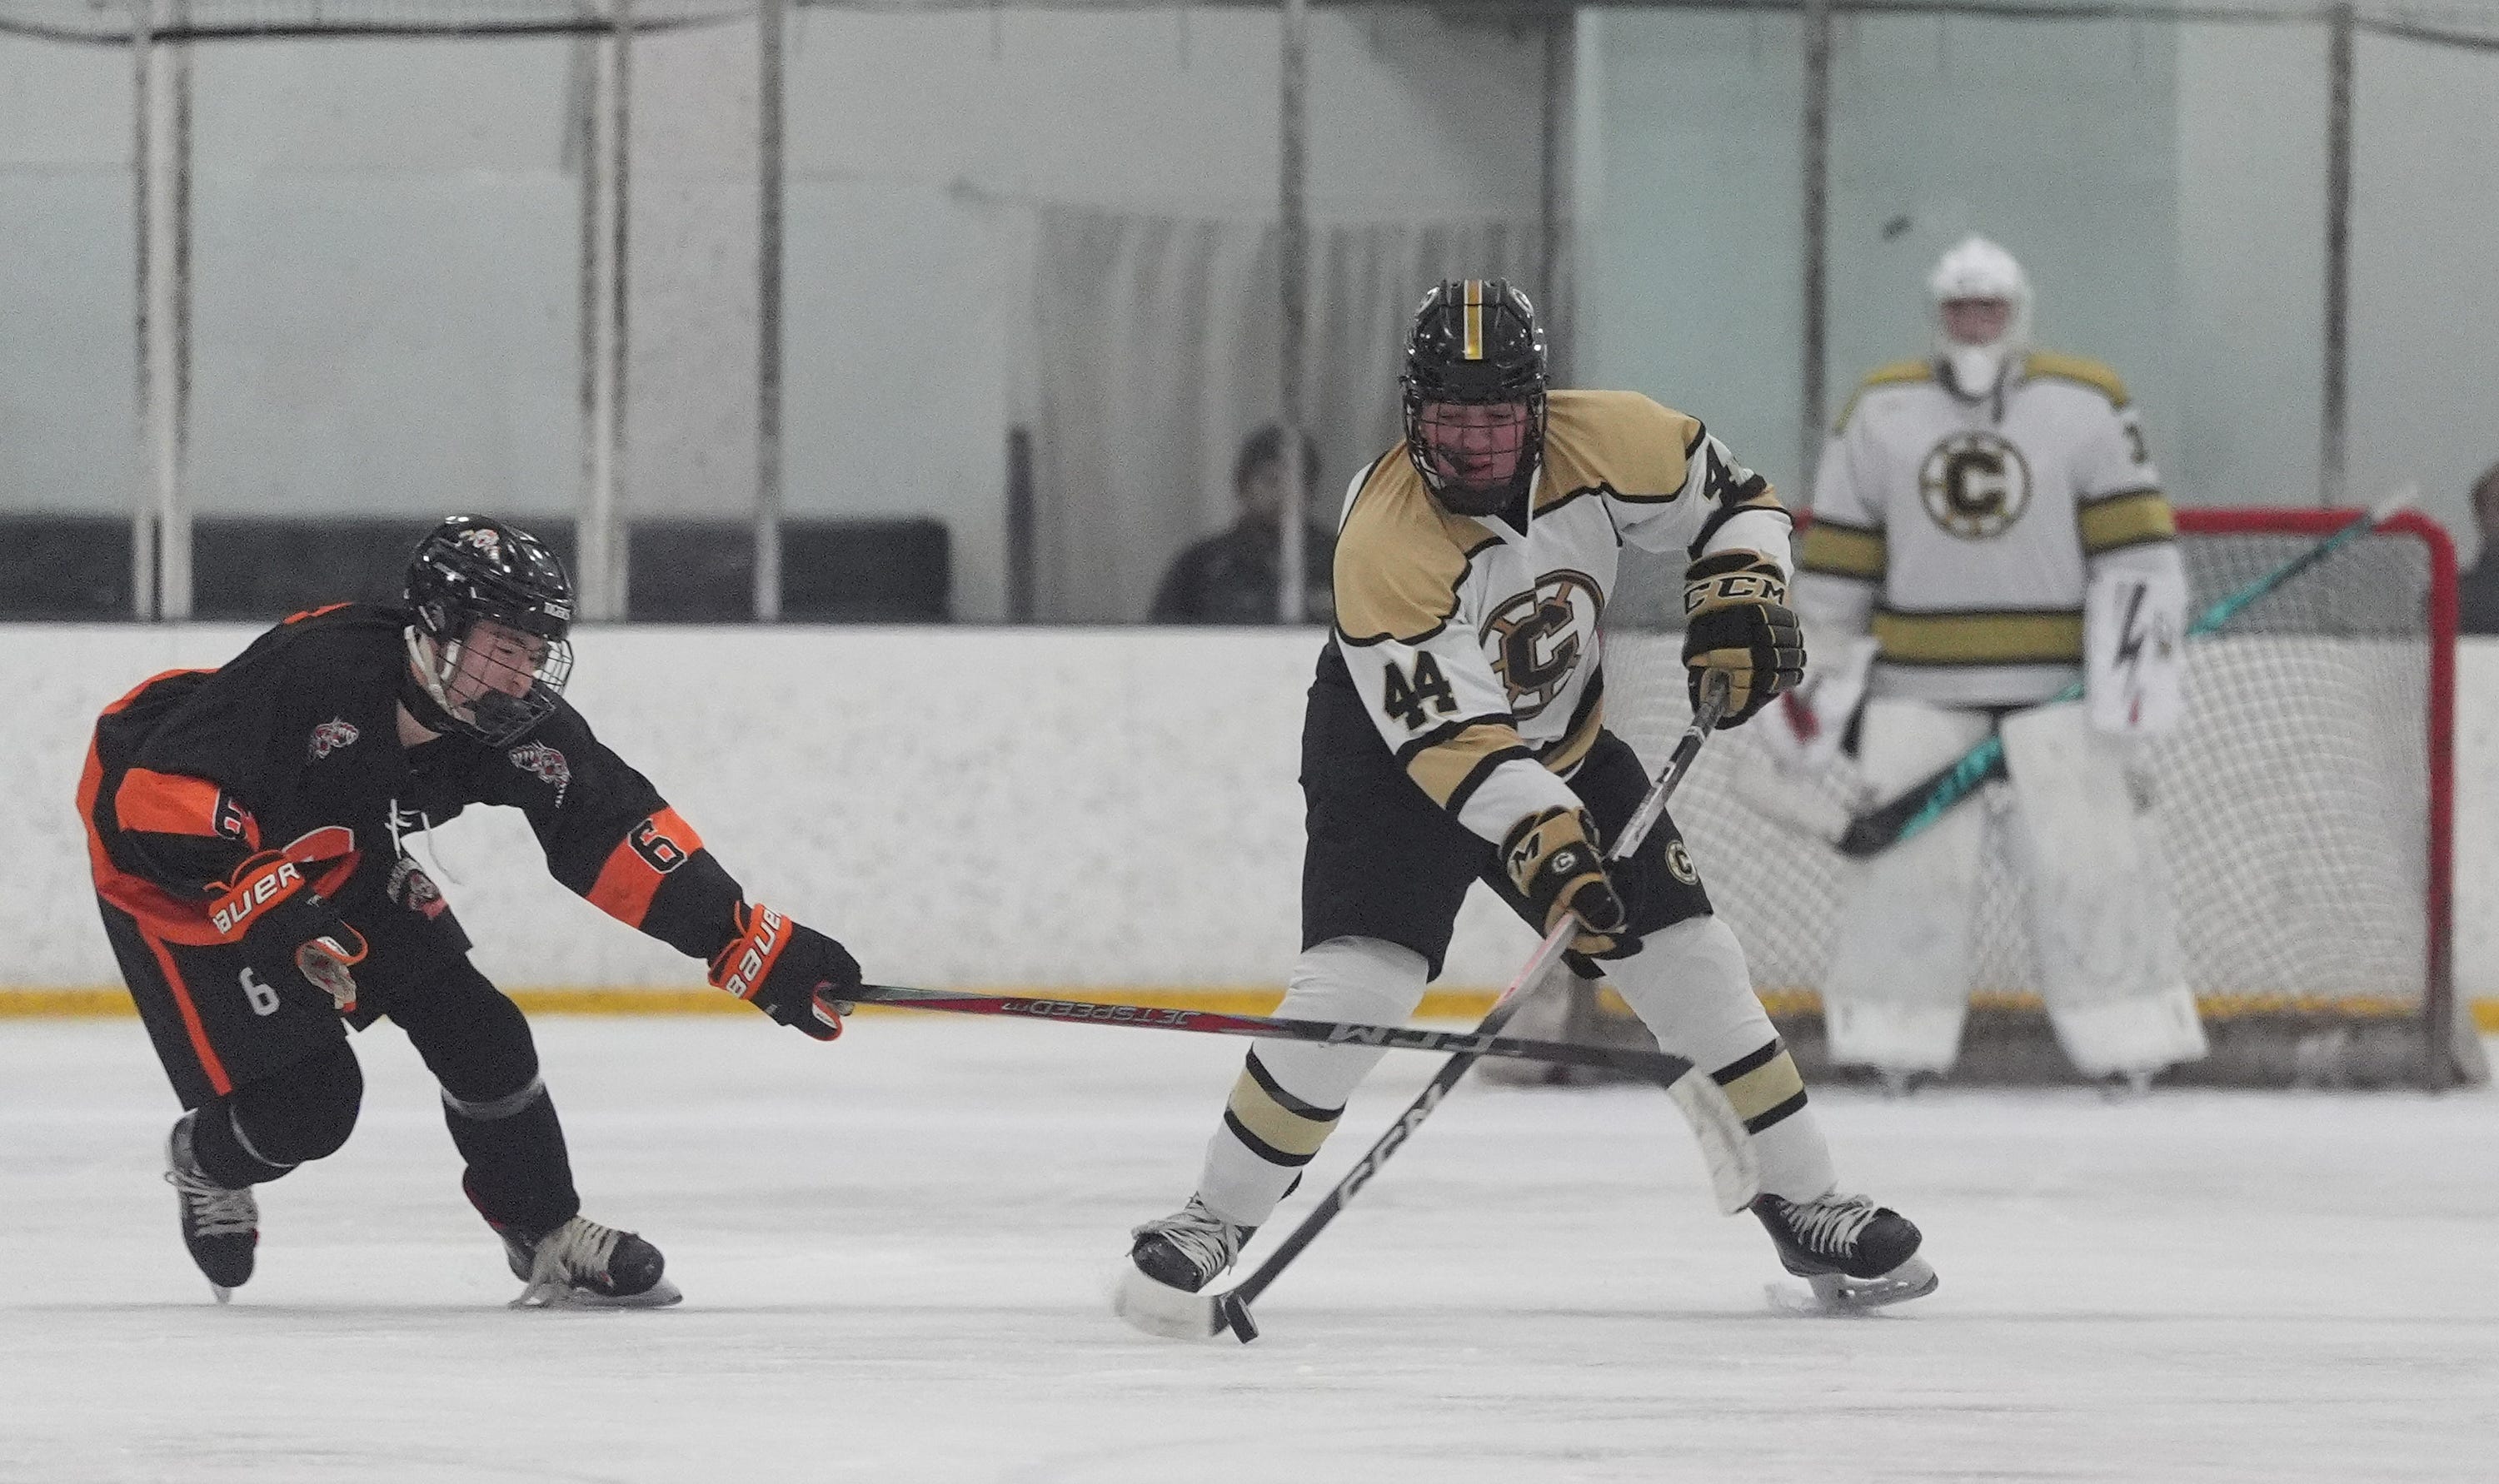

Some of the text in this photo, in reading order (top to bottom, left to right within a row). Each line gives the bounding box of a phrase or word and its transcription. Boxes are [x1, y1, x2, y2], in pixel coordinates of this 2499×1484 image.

[1944, 449, 2006, 517] C
[1684, 576, 1784, 615] CCM
[1499, 596, 1580, 695] C
[1384, 650, 1459, 732] 44
[627, 817, 688, 875] 6
[239, 966, 281, 1016] 6
[1030, 1000, 1200, 1025] JETSPEED
